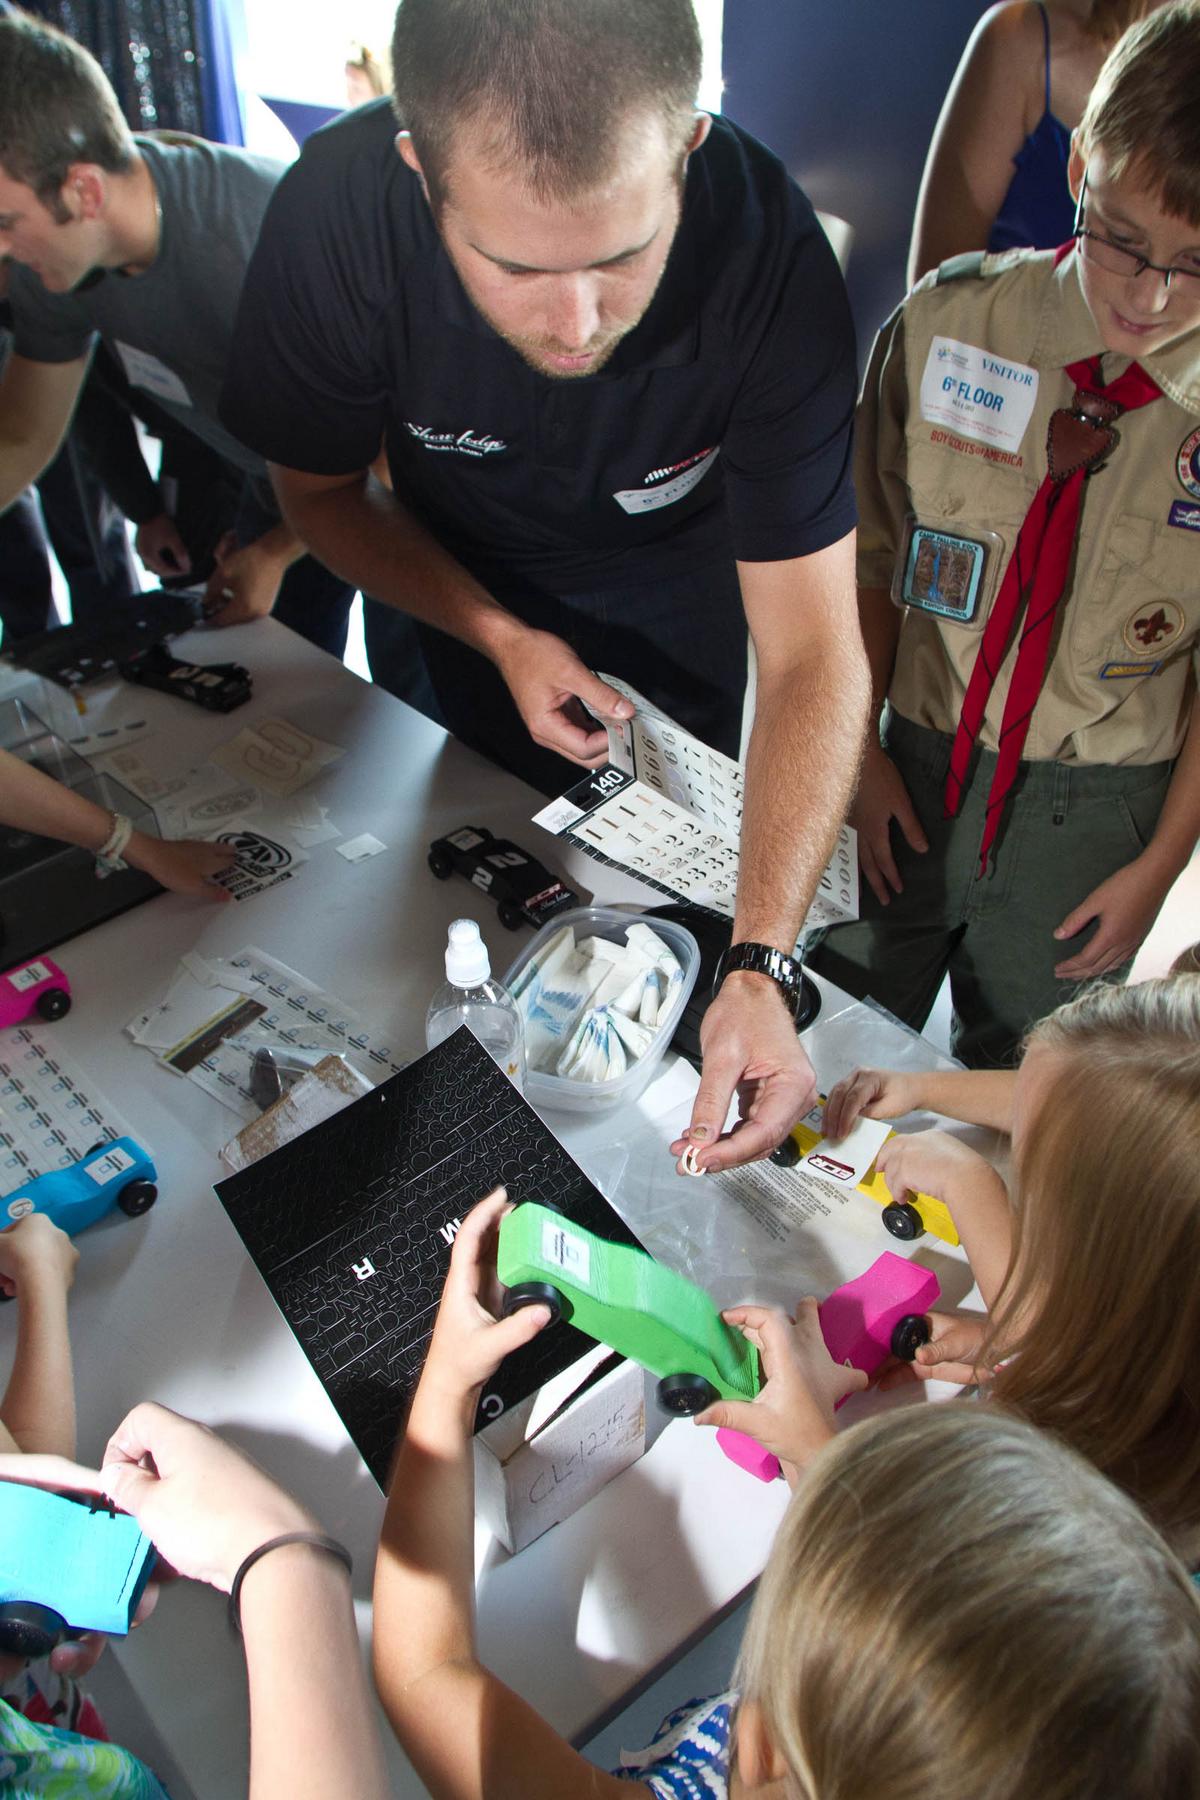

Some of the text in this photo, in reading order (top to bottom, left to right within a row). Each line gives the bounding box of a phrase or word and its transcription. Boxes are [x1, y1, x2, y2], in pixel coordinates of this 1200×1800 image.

[982, 358, 1033, 387] VISITOR
[957, 382, 1004, 412] FLOOR
[983, 448, 1023, 467] AMERICA
[590, 769, 624, 795] 140
[471, 866, 493, 892] 2
[440, 1219, 463, 1247] M
[352, 1257, 376, 1281] R
[480, 1393, 505, 1419] C
